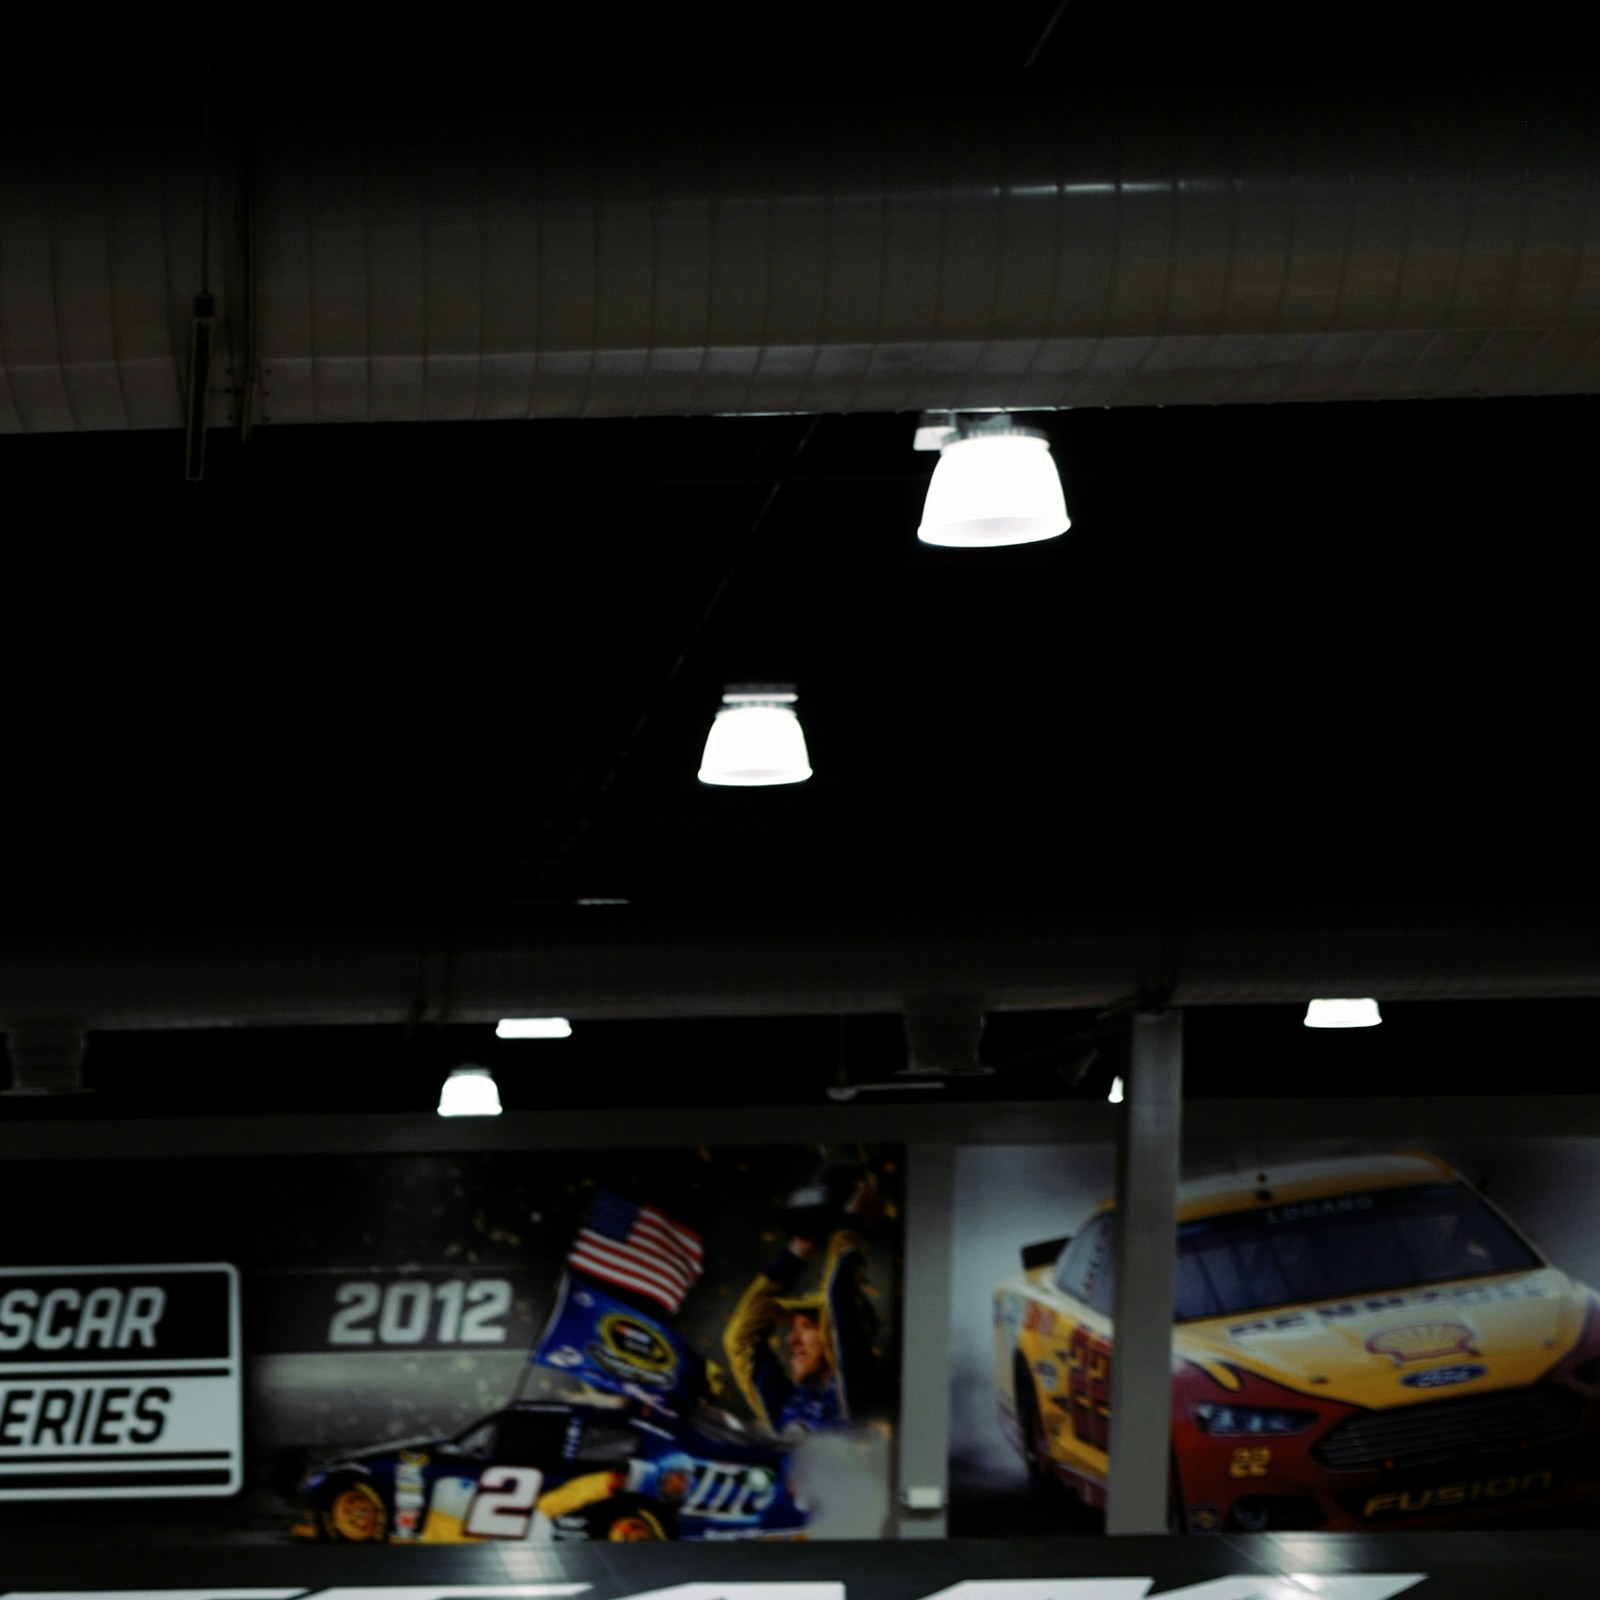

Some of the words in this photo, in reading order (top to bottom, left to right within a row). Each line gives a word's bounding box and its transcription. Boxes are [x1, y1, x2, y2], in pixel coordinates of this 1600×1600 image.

[328, 1279, 514, 1345] 2012
[1229, 1445, 1274, 1478] 22
[465, 1462, 546, 1540] 2
